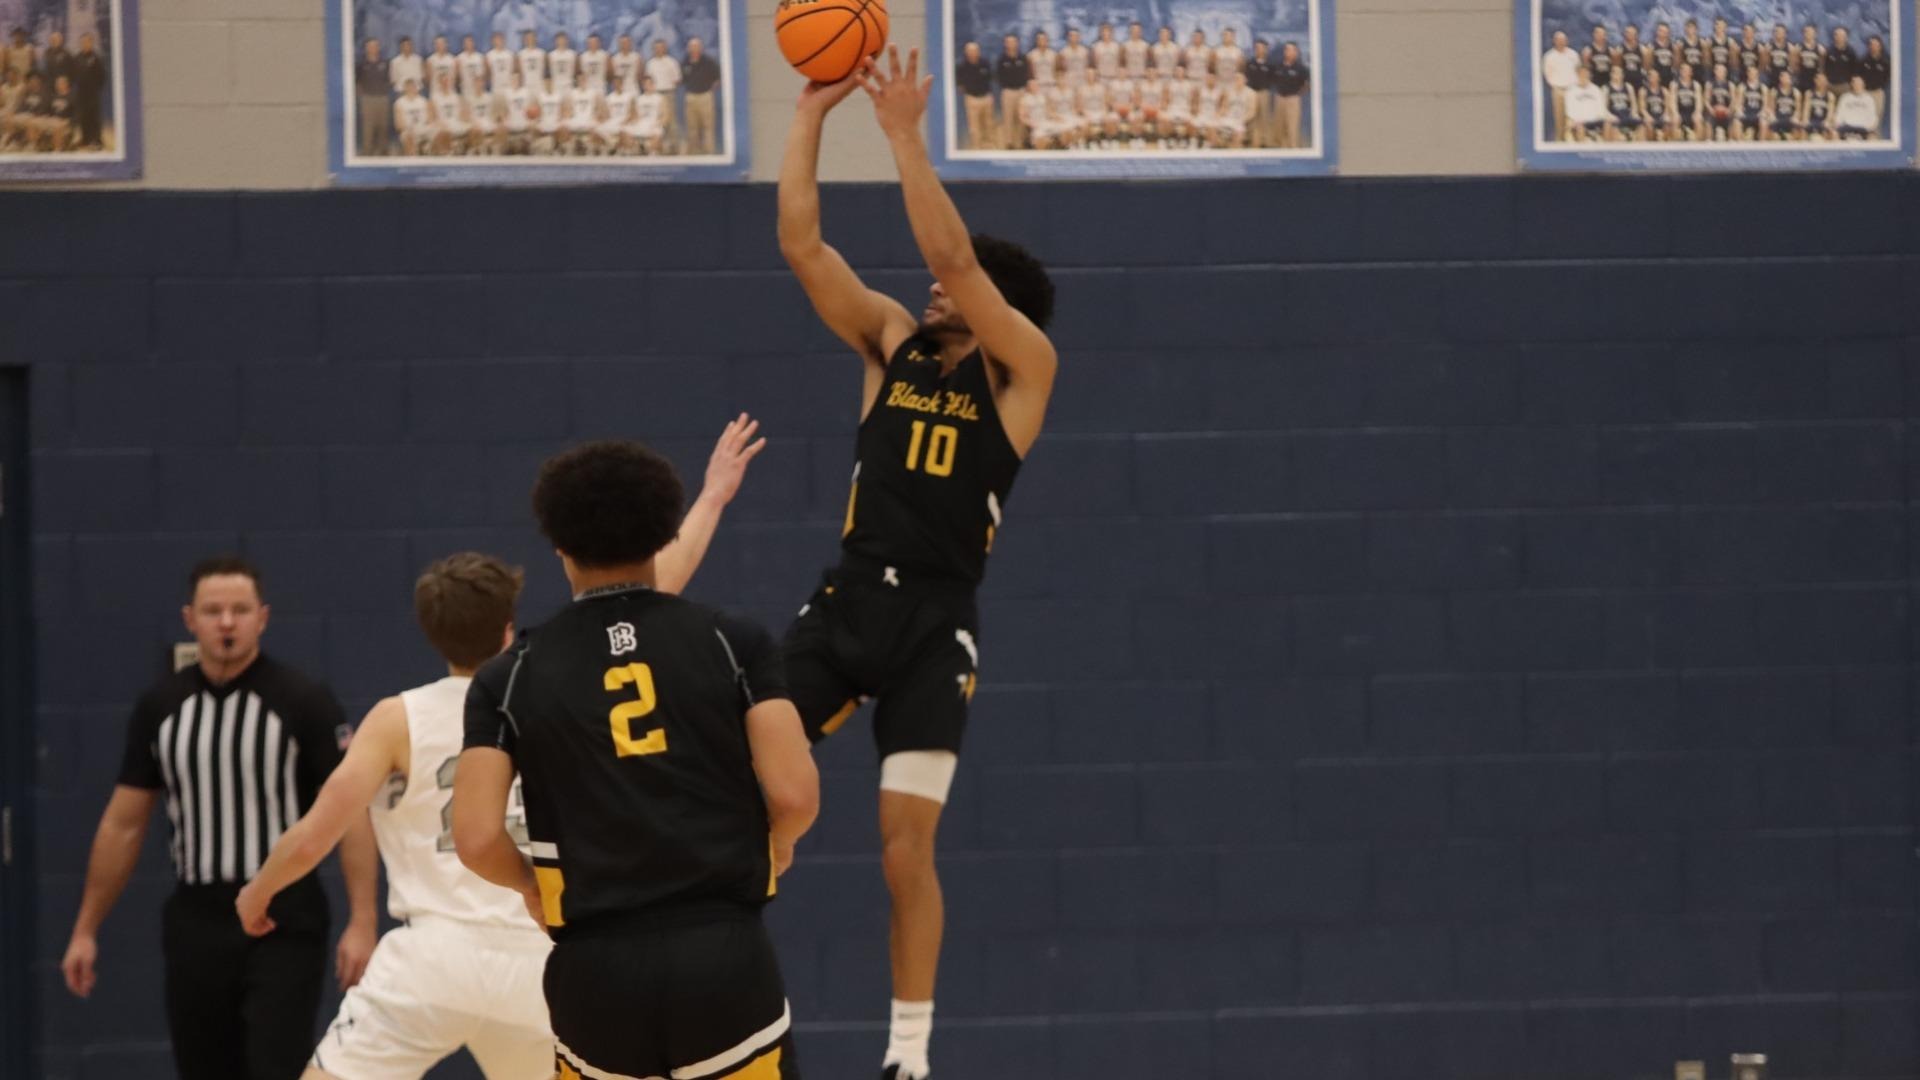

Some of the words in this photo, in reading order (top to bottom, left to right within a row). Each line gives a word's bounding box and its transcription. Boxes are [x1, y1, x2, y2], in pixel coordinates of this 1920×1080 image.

[886, 381, 941, 412] Black
[906, 419, 959, 477] 10
[604, 663, 667, 757] 2
